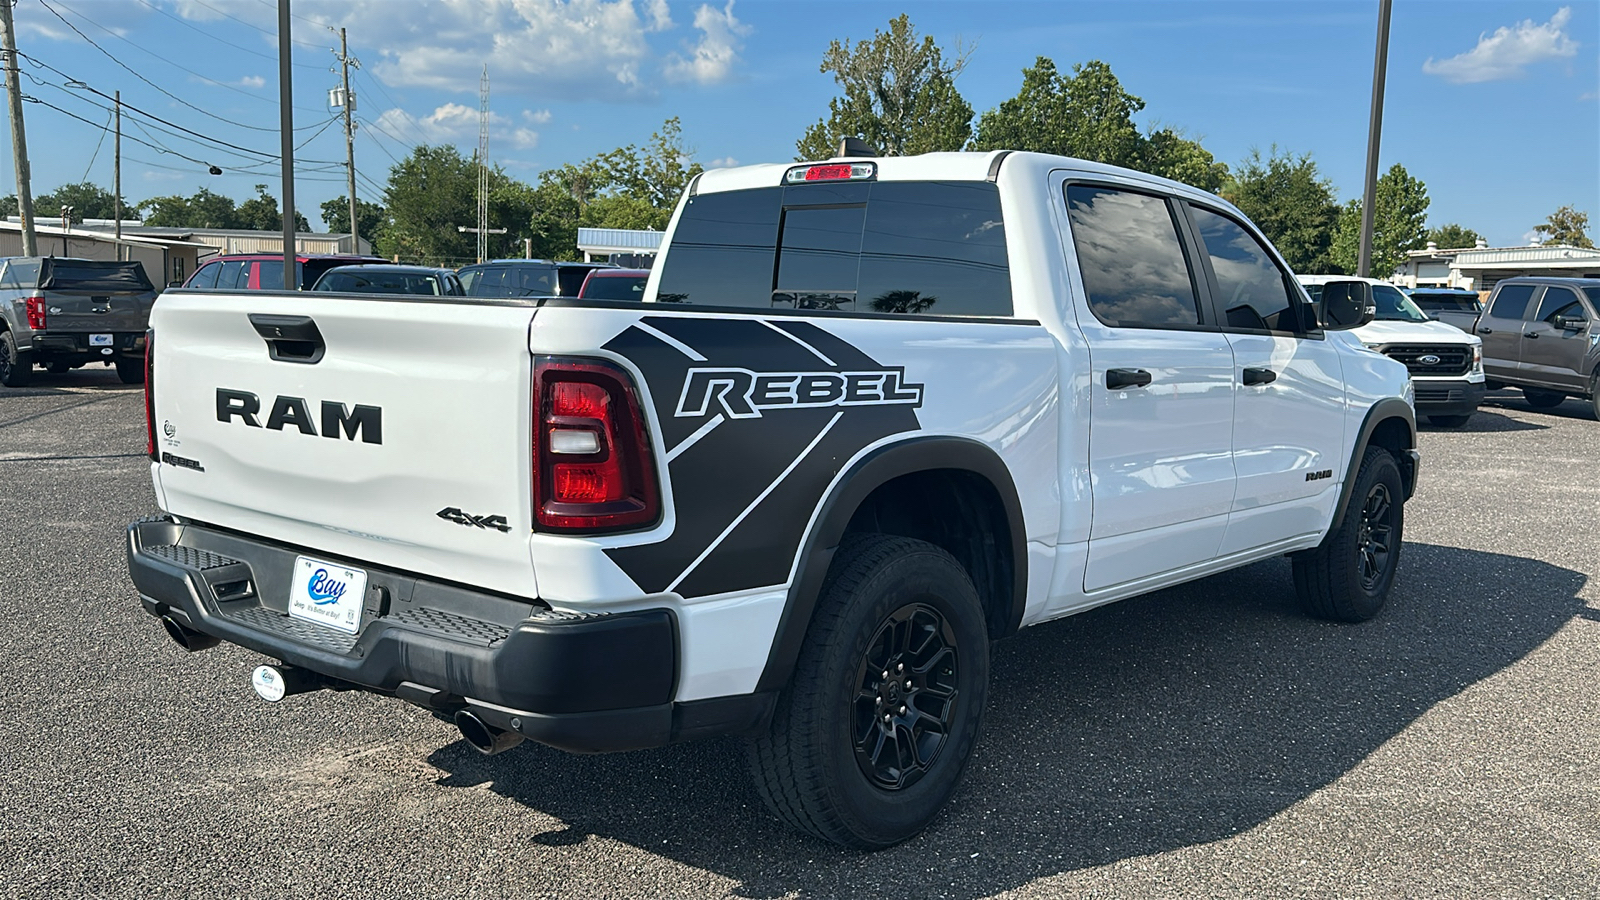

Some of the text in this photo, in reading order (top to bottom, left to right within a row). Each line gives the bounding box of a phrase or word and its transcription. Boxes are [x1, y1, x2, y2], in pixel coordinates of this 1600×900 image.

[674, 367, 921, 419] REBEL
[215, 387, 383, 445] RAM
[162, 452, 205, 473] REBEL
[1305, 469, 1333, 482] RAM
[310, 568, 347, 605] Bay
